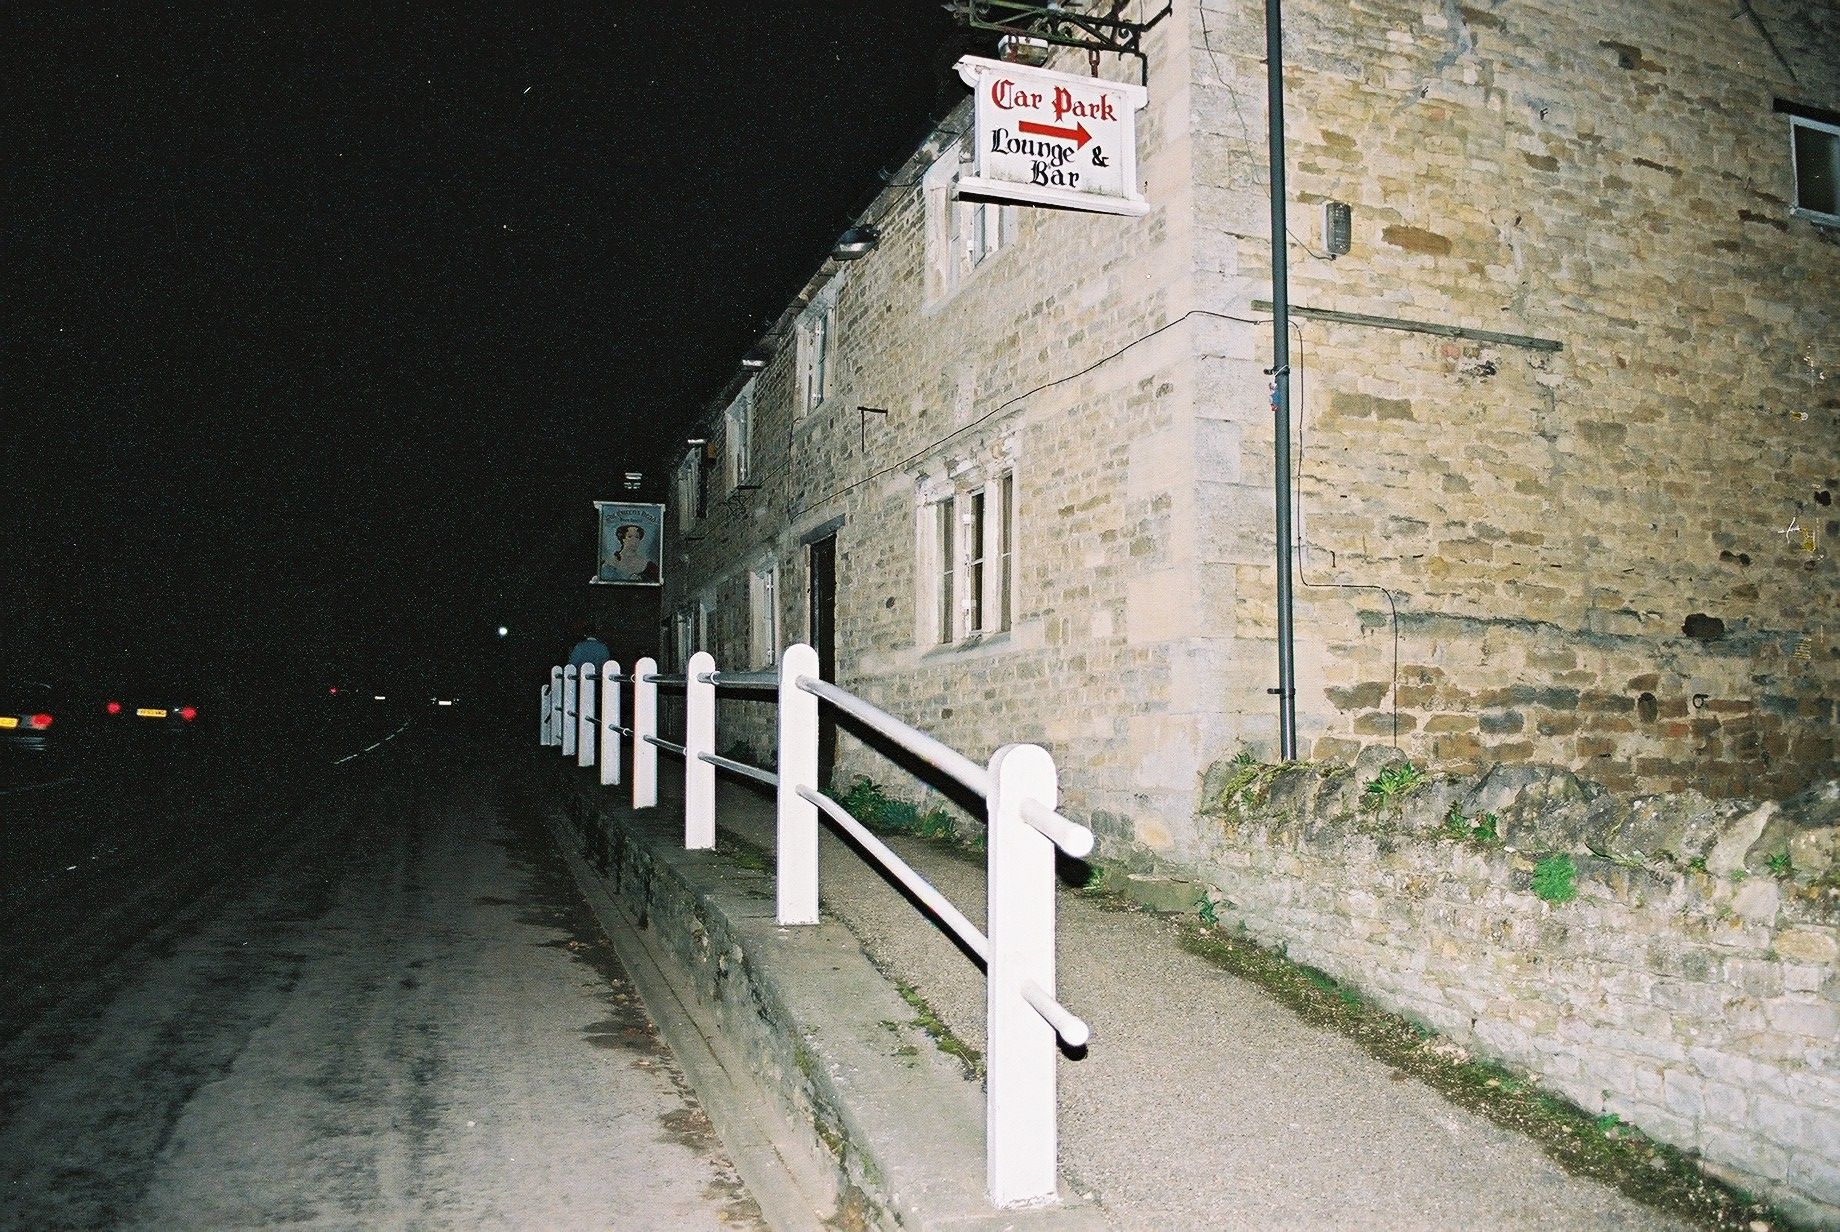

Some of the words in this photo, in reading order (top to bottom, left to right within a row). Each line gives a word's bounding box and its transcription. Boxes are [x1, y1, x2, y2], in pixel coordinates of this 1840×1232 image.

[991, 79, 1042, 110] Car
[1052, 86, 1117, 122] Park
[991, 128, 1075, 167] Lounge
[1092, 146, 1109, 167] &
[1031, 160, 1080, 188] Bar
